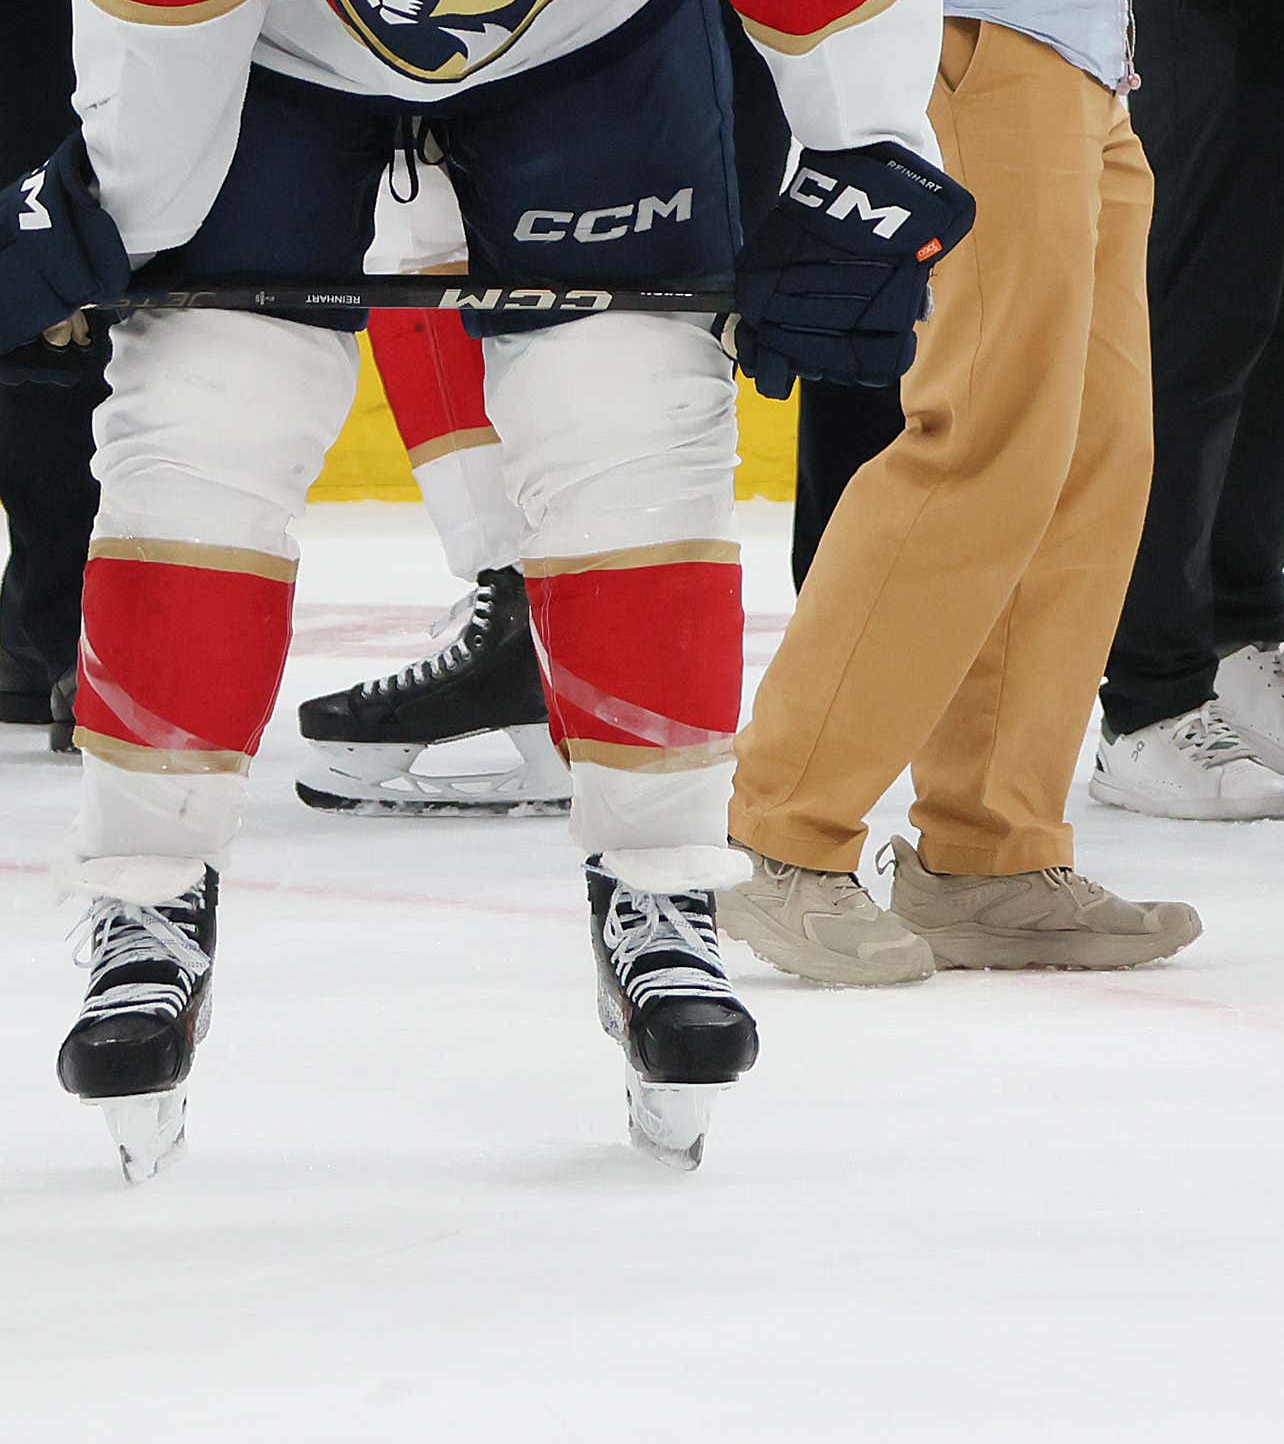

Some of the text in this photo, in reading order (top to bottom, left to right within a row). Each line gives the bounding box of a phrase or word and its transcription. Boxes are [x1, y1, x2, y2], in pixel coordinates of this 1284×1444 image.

[886, 159, 944, 193] REINHART
[512, 187, 694, 243] CCM
[304, 293, 361, 305] REINHART
[438, 288, 613, 311] CCM
